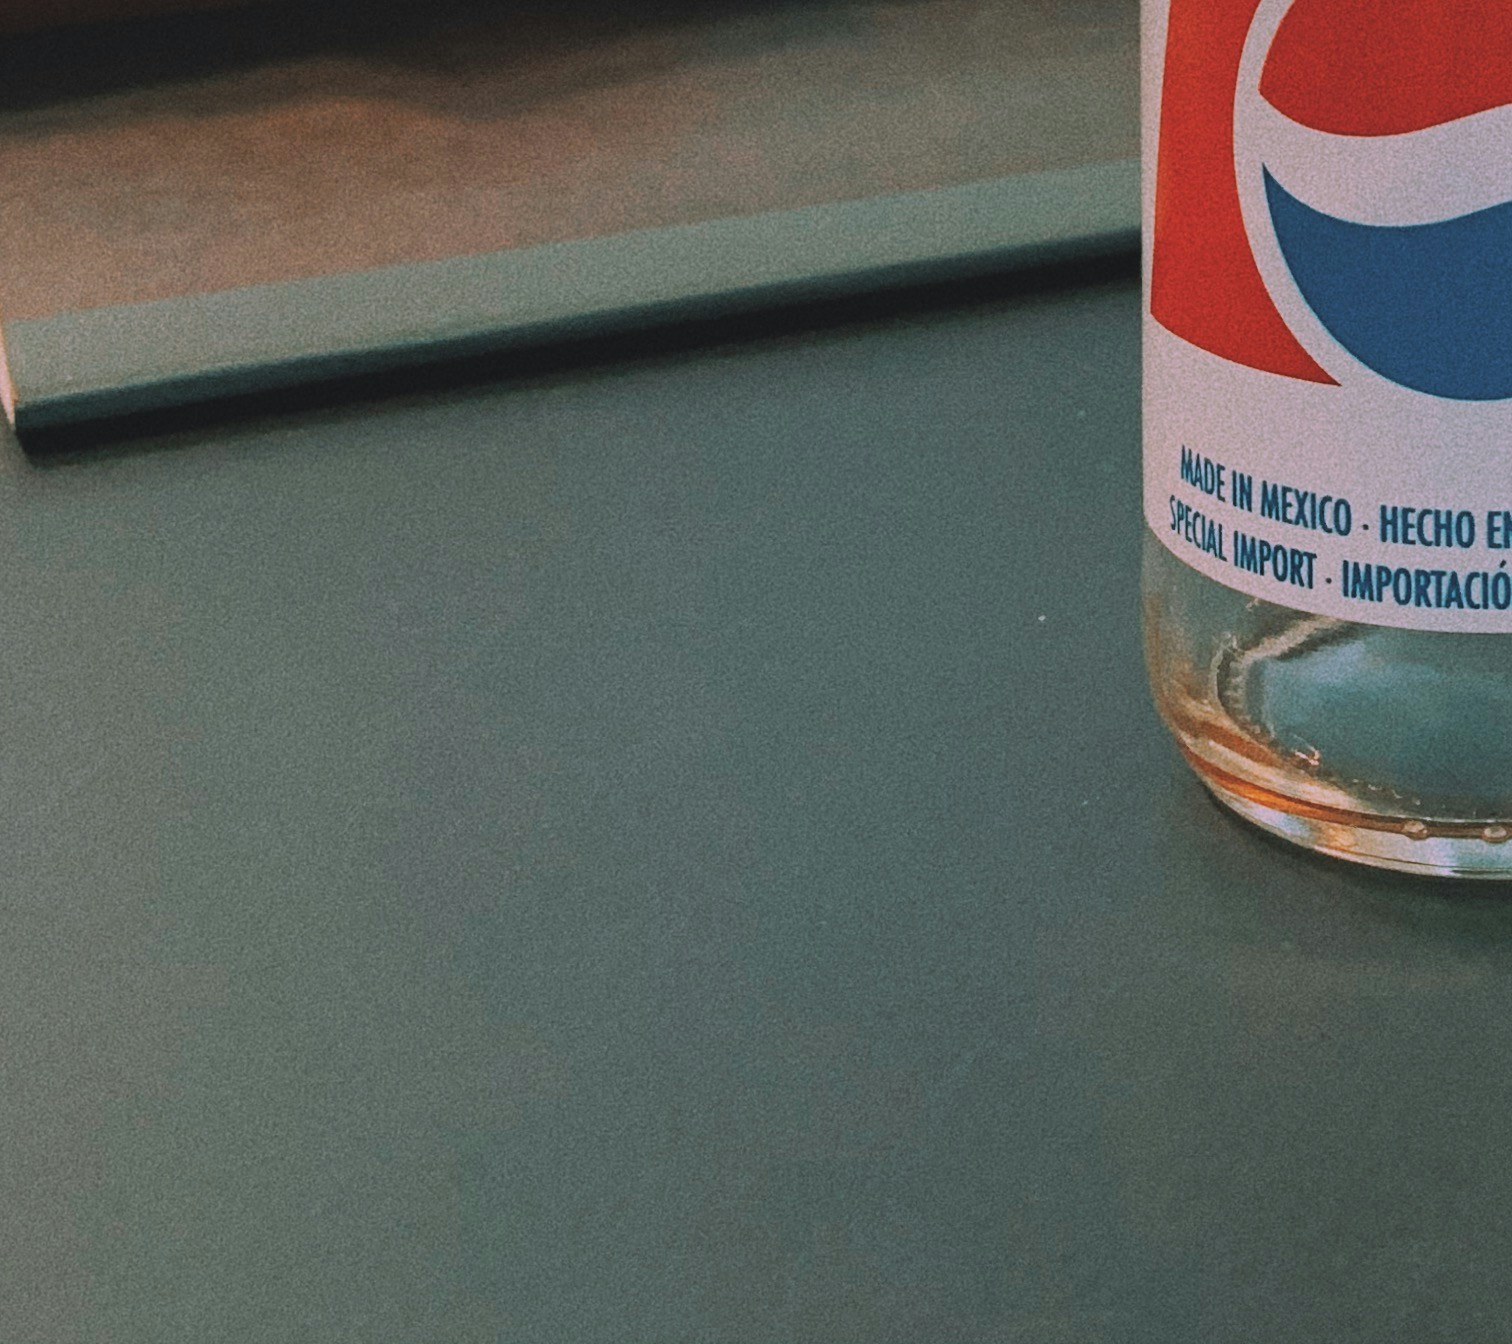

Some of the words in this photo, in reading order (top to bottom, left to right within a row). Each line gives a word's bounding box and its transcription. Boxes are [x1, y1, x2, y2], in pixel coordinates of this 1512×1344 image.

[1169, 494, 1228, 563] SPECIAL
[1233, 529, 1318, 590] IMPORT
[1180, 444, 1226, 503] MADE
[1231, 469, 1253, 513] IN
[1260, 479, 1352, 537] MEXICO
[1379, 504, 1476, 549] HECHO
